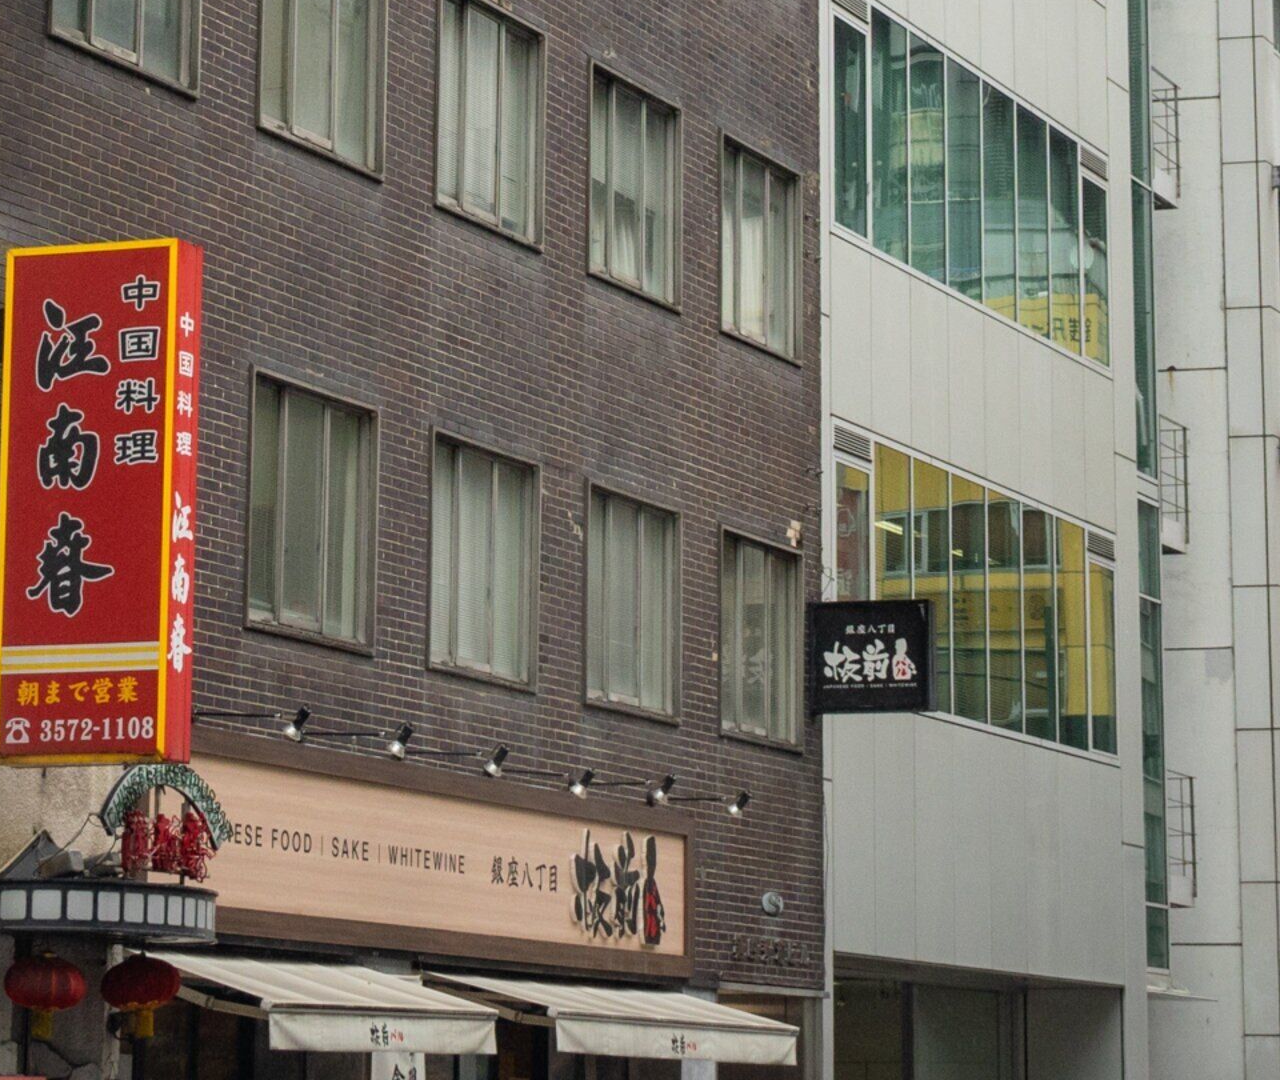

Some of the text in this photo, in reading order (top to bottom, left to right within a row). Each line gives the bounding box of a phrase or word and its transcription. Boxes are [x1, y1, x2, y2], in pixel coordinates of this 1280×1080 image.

[113, 274, 162, 466] 中国料理
[175, 311, 195, 458] 中国料理
[25, 298, 116, 619] 江南春
[16, 674, 140, 706] 朝まで営業
[39, 716, 155, 743] 3572-1108
[270, 828, 313, 854] FOOD
[330, 836, 370, 862] SAKE
[387, 845, 466, 875] WHITEWINE
[490, 855, 559, 893] 銀座八丁目
